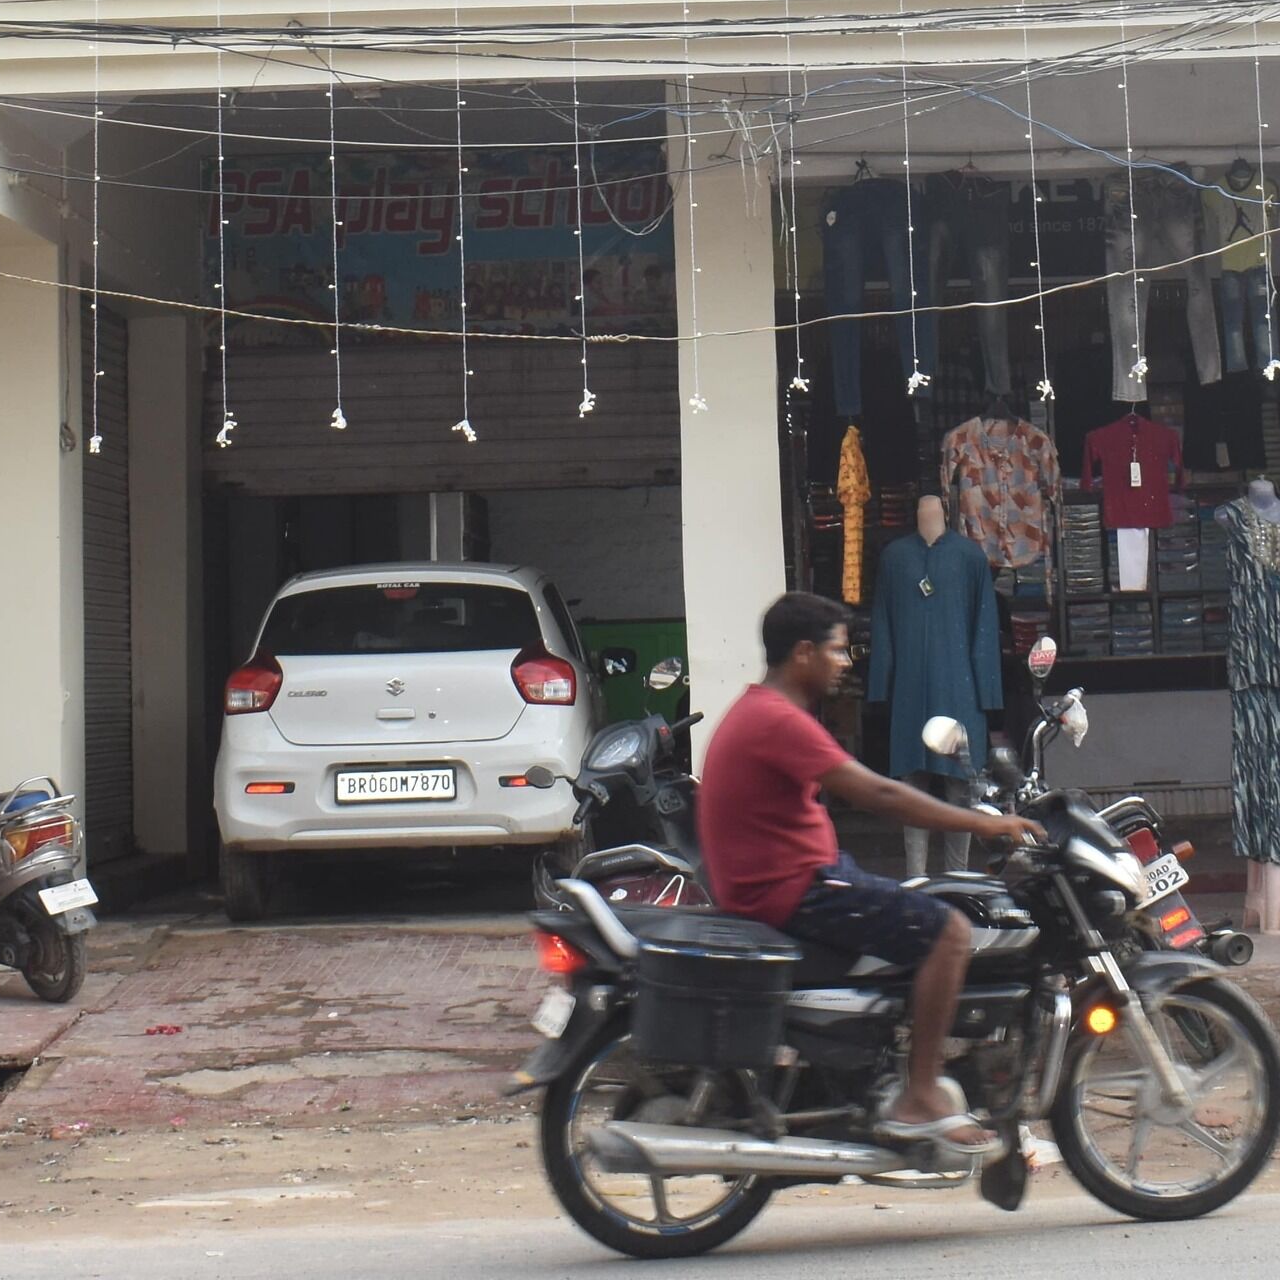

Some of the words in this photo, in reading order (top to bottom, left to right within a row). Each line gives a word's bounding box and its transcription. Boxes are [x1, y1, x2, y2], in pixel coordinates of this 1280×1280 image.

[207, 167, 314, 239] PSA
[336, 166, 459, 257] play
[475, 160, 669, 229] school
[1028, 217, 1072, 234] since
[1078, 215, 1105, 233] 187
[347, 774, 451, 794] BR06DM7870
